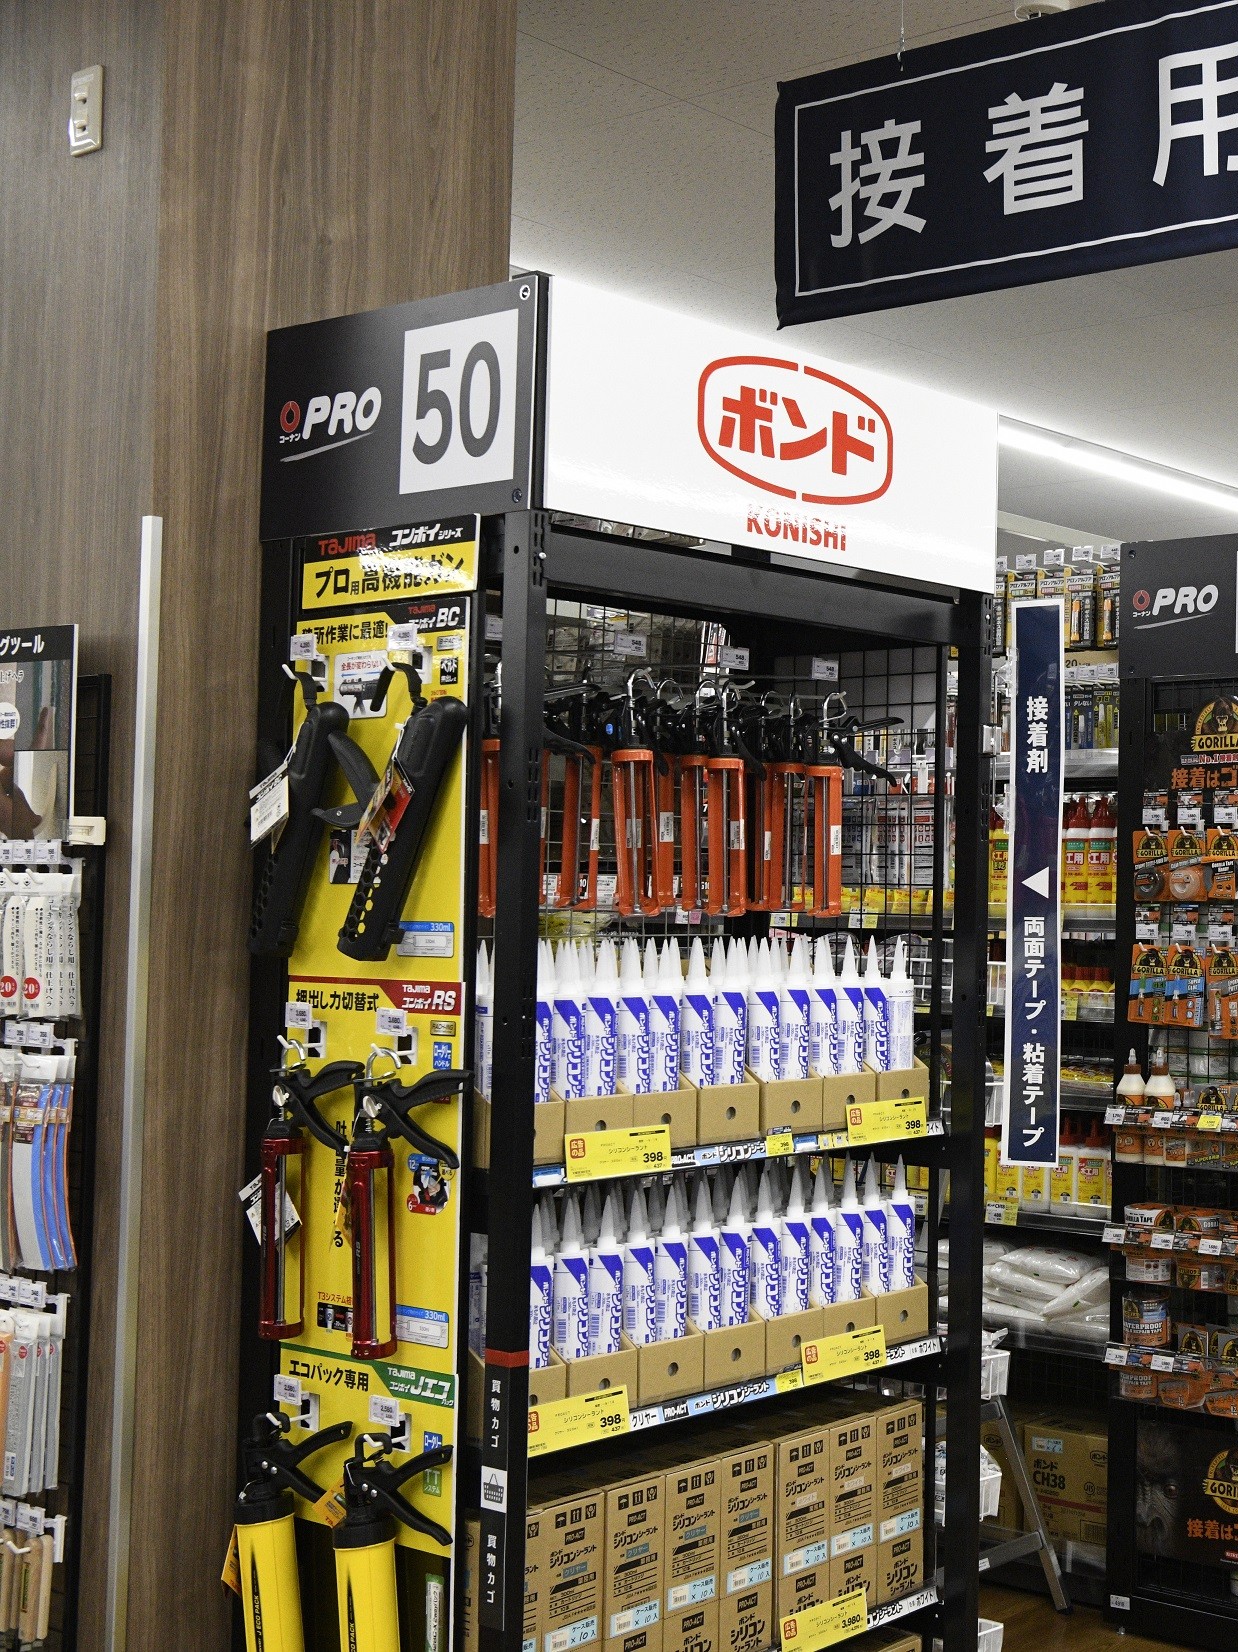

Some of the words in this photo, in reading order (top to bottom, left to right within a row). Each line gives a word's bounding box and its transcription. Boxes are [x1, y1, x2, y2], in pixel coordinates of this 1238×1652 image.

[411, 340, 500, 465] 50
[302, 386, 381, 441] PRO
[720, 384, 876, 476] ボンド
[745, 502, 847, 552] KONISHI
[318, 533, 377, 556] Tajima
[1152, 584, 1219, 616] PRO
[436, 606, 460, 628] BC
[1026, 696, 1049, 774] 接着剤
[430, 922, 451, 932] 330ml
[1212, 966, 1236, 975] GORILLA
[402, 984, 431, 994] Tajima
[431, 990, 457, 1011] RS
[1021, 916, 1047, 1147] 両面テープ・粘着テープ
[905, 1120, 921, 1130] 398
[643, 1151, 663, 1163] 398
[424, 1309, 446, 1321] 330ml
[864, 1350, 881, 1362] 398
[918, 1341, 938, 1355] ホワイト
[289, 1358, 369, 1392] エコパック専用
[387, 1366, 415, 1379] Tajima
[490, 1379, 502, 1448] 買物カゴ
[631, 1412, 657, 1428] クリヤー
[663, 1404, 690, 1419] PRO-ACT
[694, 1399, 711, 1410] ボンド
[712, 1380, 770, 1409] シリコンシーラント
[600, 1413, 622, 1428] 398
[882, 1447, 917, 1468] シリコンシーラント
[1033, 1458, 1059, 1471] ボンド
[834, 1461, 871, 1481] シリコンシーラント
[1032, 1470, 1066, 1490] CH38
[786, 1477, 824, 1497] シリコンシーラント
[728, 1493, 767, 1513] シリコンシーラント
[673, 1510, 715, 1531] シリコンシーラント
[614, 1526, 658, 1549] シリコンシーラント
[550, 1544, 597, 1569] シリコンシーラント
[892, 1539, 911, 1557] PRO-ACT
[486, 1534, 498, 1605] 買物カゴ
[844, 1556, 863, 1572] PRO-ACT
[893, 1558, 909, 1570] ボンド
[796, 1575, 816, 1591] PRO-ACT
[845, 1573, 862, 1586] ボンド
[886, 1563, 917, 1586] シリコン
[890, 1579, 915, 1596] シーラント
[738, 1595, 758, 1610] PRO-ACT
[916, 1590, 935, 1608] ホワイト
[683, 1614, 704, 1629] PRO-ACT
[739, 1613, 755, 1625] ボンド
[841, 1614, 862, 1630] 3,980
[684, 1632, 701, 1645] ボンド
[731, 1619, 765, 1645] シリコン
[624, 1635, 646, 1649] PRO-ACT
